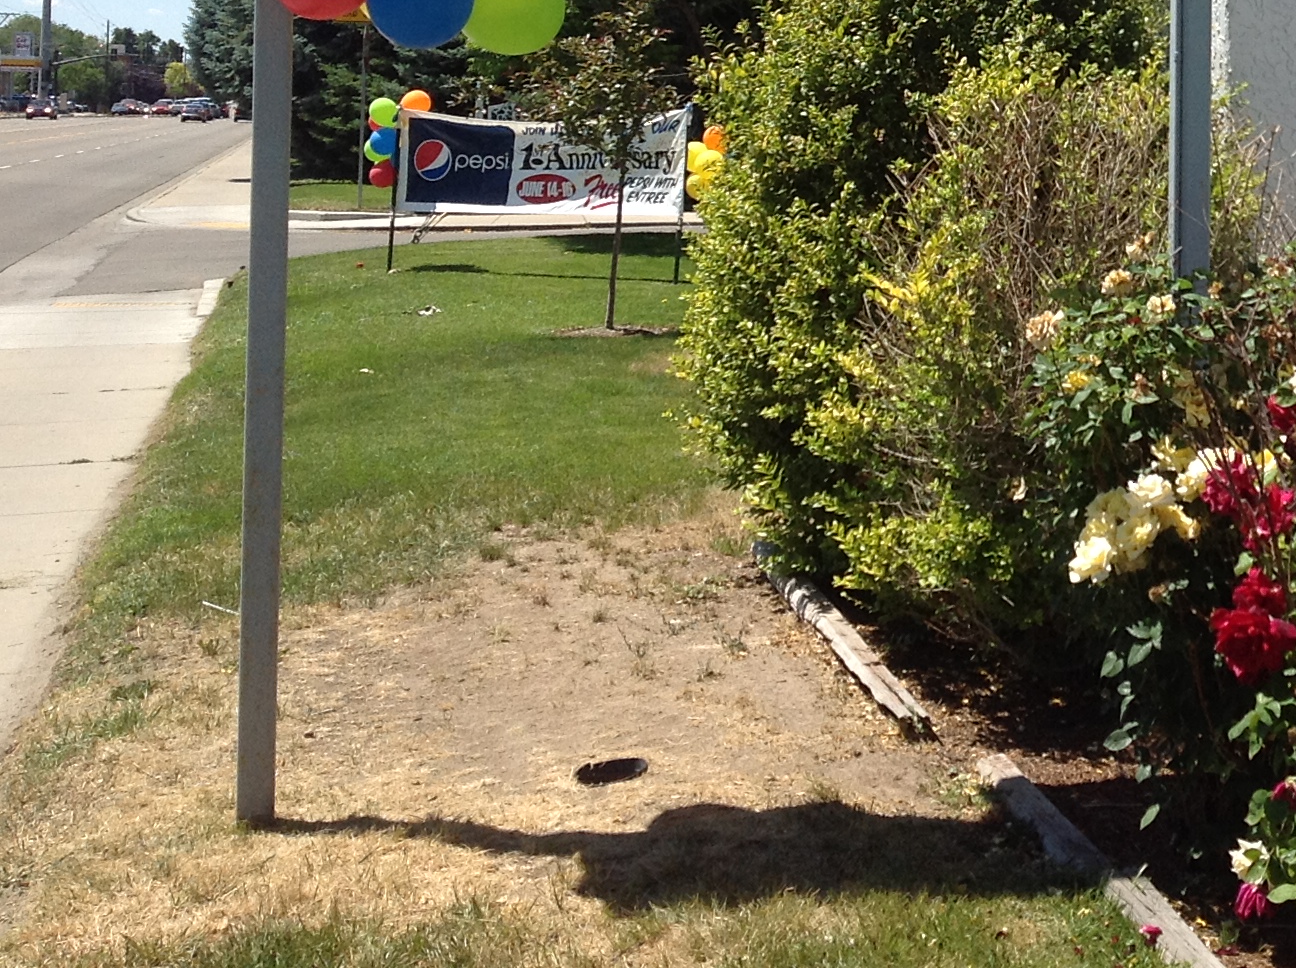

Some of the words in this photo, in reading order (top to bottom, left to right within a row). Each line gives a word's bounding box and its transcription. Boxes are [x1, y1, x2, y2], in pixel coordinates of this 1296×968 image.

[522, 126, 546, 135] JOIN
[651, 119, 681, 134] OUR
[455, 151, 510, 173] pepsi
[519, 181, 545, 197] JUNE
[584, 174, 620, 207] Free
[625, 176, 654, 189] PEPSI
[655, 177, 679, 188] WITH
[626, 191, 669, 203] ENTREE
